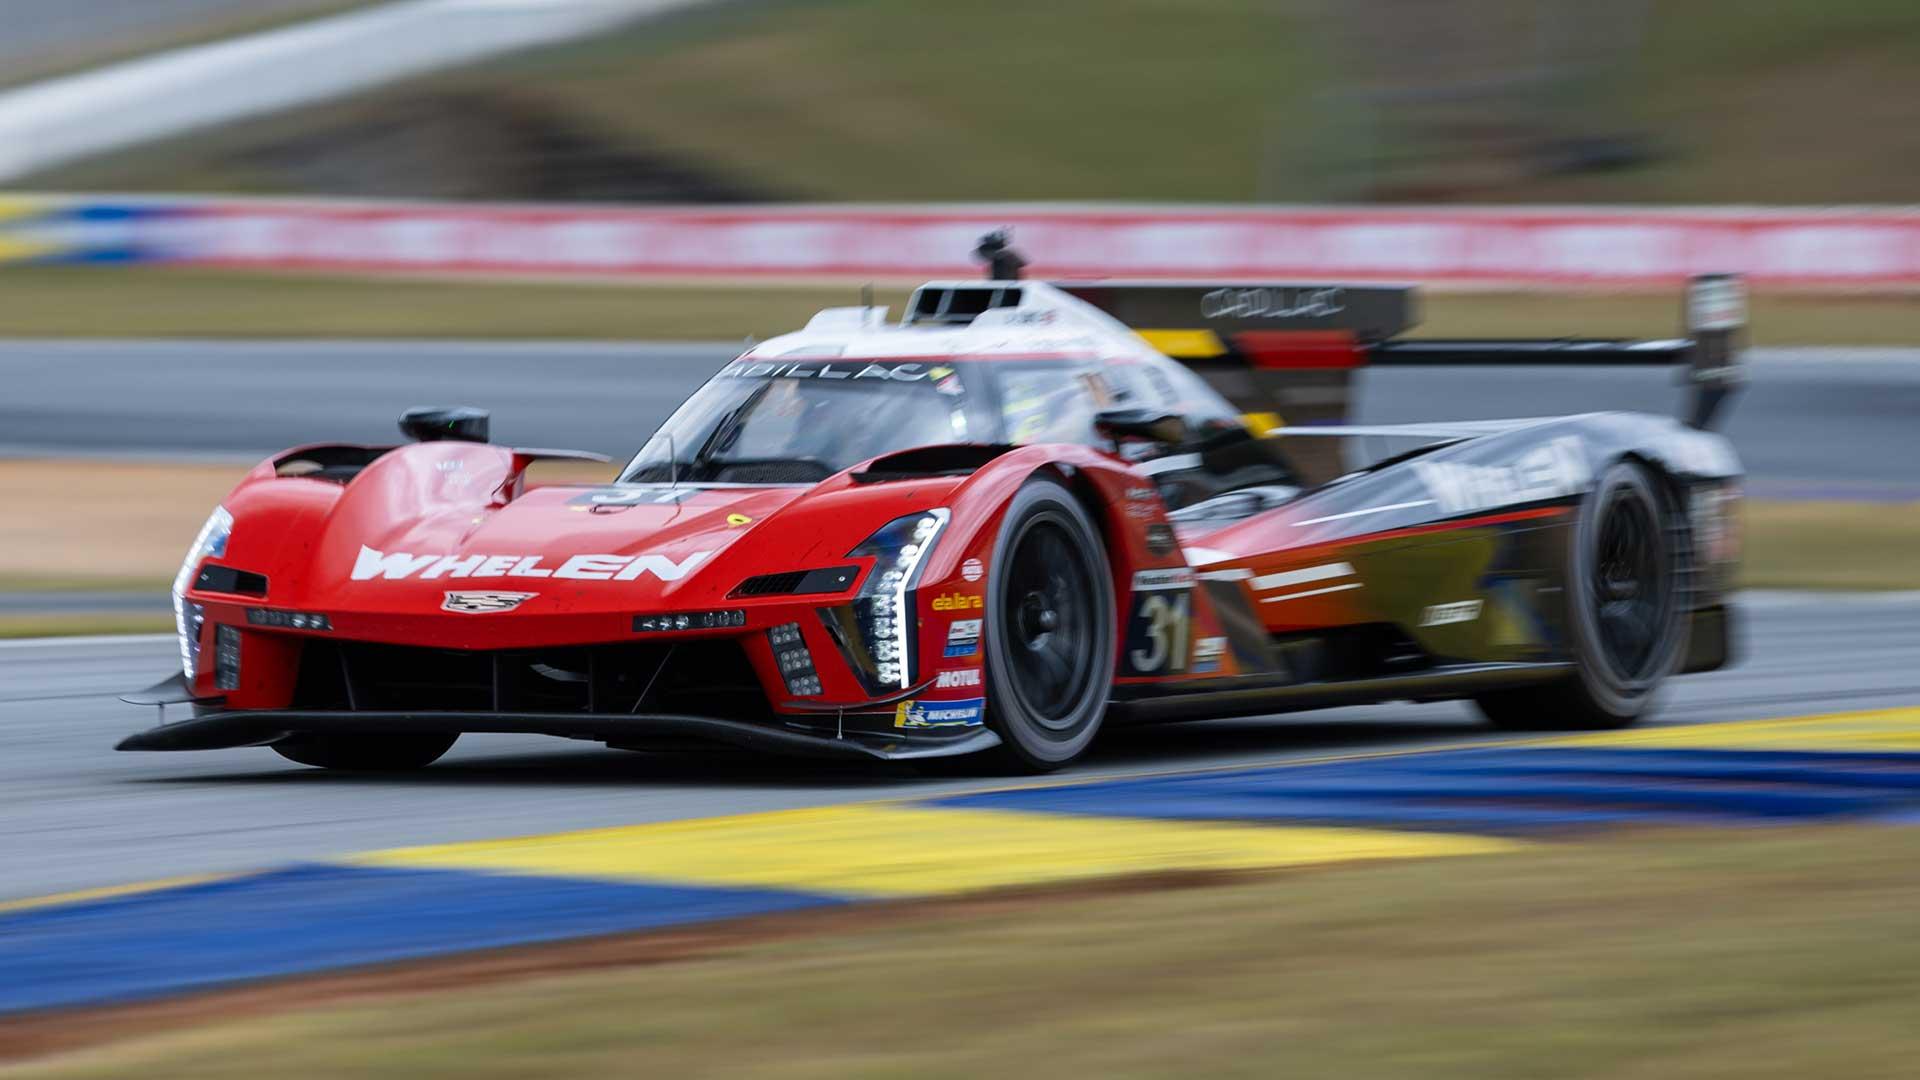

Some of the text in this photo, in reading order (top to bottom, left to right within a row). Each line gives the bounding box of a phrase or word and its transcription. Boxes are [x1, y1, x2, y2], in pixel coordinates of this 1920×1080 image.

[351, 544, 712, 581] WHELEN
[1130, 592, 1190, 672] 31
[935, 669, 981, 688] MOTUL
[927, 708, 978, 721] MICHELIN
